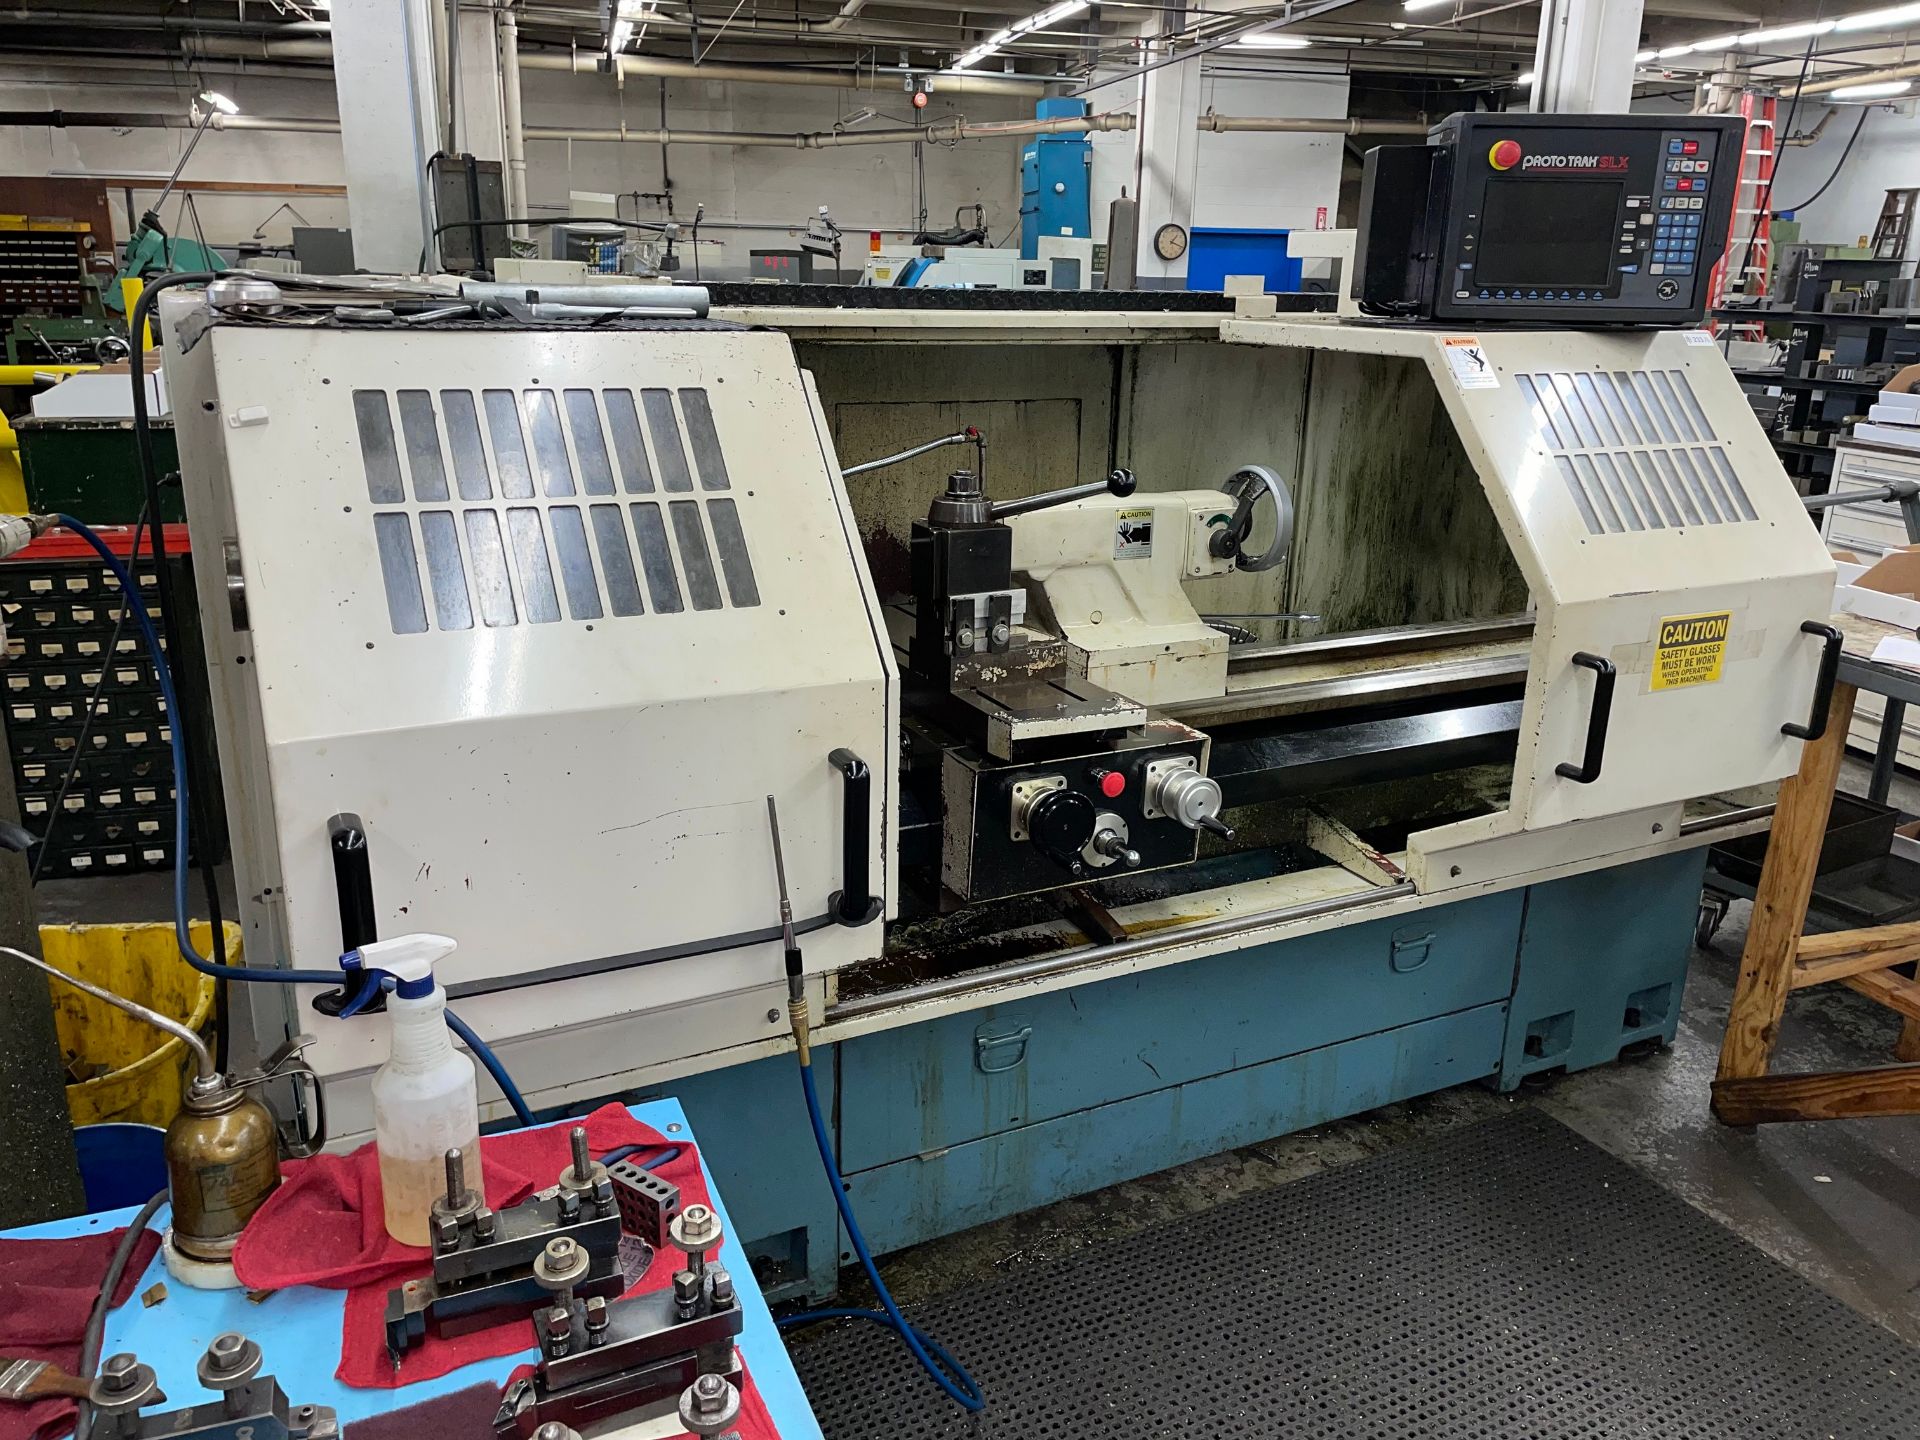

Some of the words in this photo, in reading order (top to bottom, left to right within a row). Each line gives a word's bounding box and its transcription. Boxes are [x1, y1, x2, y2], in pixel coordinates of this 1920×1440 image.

[1599, 155, 1629, 168] SLX
[1663, 619, 1727, 644] CAUTION
[1660, 648, 1688, 660] SAFETY
[1689, 644, 1721, 656] GLASSES
[1661, 659, 1683, 670] MUST
[1684, 658, 1695, 668] BE
[1696, 654, 1717, 666] WORN
[1662, 670, 1680, 679] WHEN
[1680, 665, 1713, 676] OPERATING
[1665, 678, 1679, 686] THIS
[1680, 673, 1707, 683] MACHINE
